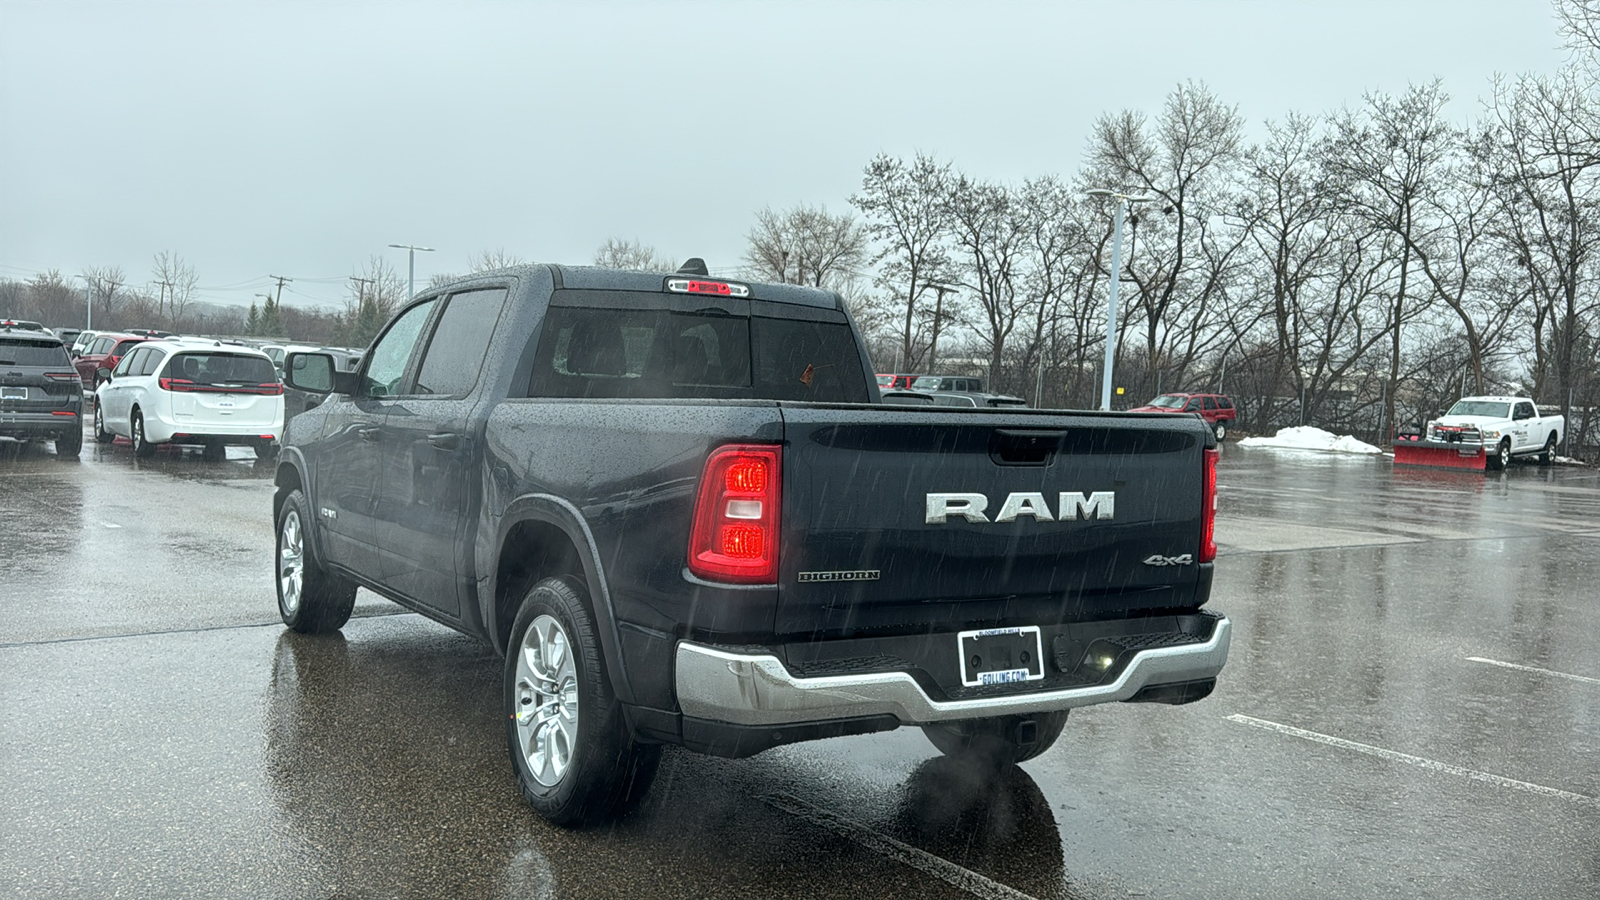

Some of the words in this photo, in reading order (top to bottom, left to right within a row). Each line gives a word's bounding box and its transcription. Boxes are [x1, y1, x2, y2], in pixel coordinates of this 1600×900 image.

[925, 491, 1115, 524] RAM
[1142, 553, 1193, 566] 4x4
[798, 569, 880, 582] BIGHORN
[979, 629, 1007, 637] BLOOMFIELD
